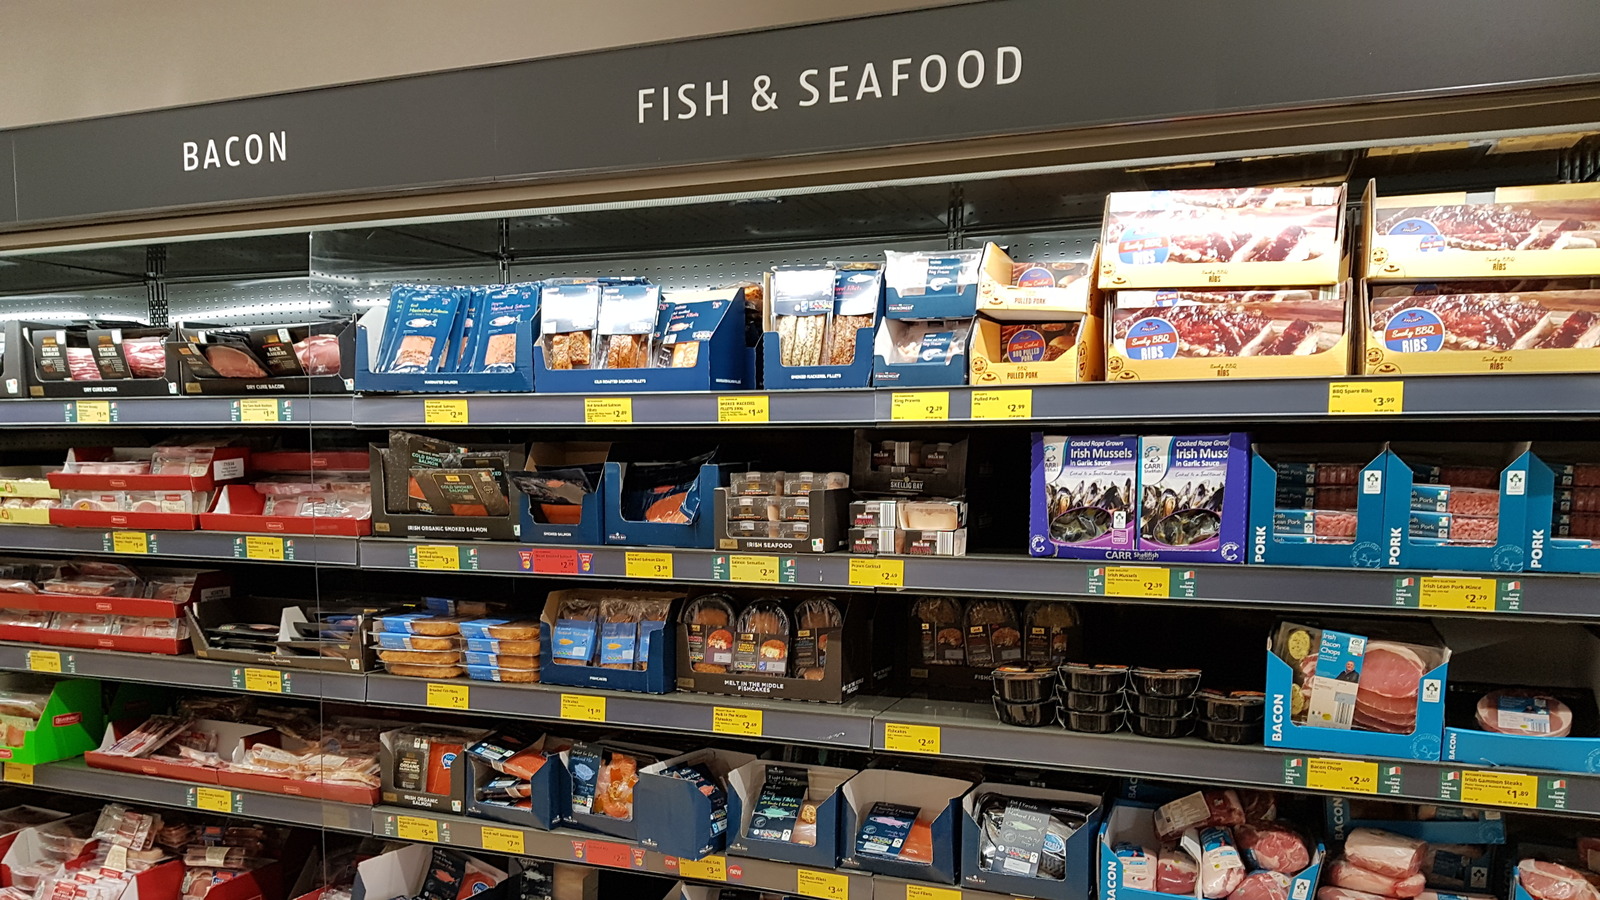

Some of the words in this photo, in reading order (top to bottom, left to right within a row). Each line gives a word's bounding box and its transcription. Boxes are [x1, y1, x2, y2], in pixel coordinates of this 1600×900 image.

[637, 79, 731, 125] FISH
[750, 74, 779, 112] &
[798, 45, 1024, 108] SEAFOOD
[183, 130, 288, 172] BACON
[1492, 262, 1506, 271] RIBS
[1208, 275, 1221, 283] RIBS
[1415, 325, 1436, 336] BBQ
[1152, 334, 1171, 343] BBQ
[1402, 337, 1428, 352] RIBS
[1141, 345, 1164, 360] RIBS
[1489, 362, 1504, 370] RIBS
[1024, 371, 1038, 379] PORK
[1216, 369, 1230, 377] RIBS
[1373, 397, 1395, 407] €3.99
[925, 405, 943, 414] €2.29
[1007, 404, 1025, 412] €2.99
[1091, 440, 1105, 448] Rope
[1196, 440, 1210, 448] Rope
[1070, 448, 1091, 459] Irish
[1092, 448, 1133, 459] Mussels
[1176, 448, 1197, 459] Irish
[1199, 448, 1228, 459] Muss
[890, 481, 912, 489] SKELLIG
[912, 482, 923, 490] BAY
[1418, 496, 1434, 504] Pork
[1254, 525, 1267, 563] PORK
[1388, 527, 1402, 566] PORK
[1530, 529, 1545, 569] PORK
[1105, 551, 1132, 560] CARR
[1133, 551, 1159, 559] Shellfish
[1143, 582, 1163, 591] €2.39
[1465, 594, 1488, 603] €2.79
[1322, 632, 1337, 641] Irish
[1321, 640, 1341, 649] Bacon
[1320, 646, 1341, 657] Chops
[737, 685, 771, 693] FISHCAKES
[761, 682, 784, 690] MIDDLE
[1271, 693, 1284, 742] BACON
[1448, 732, 1457, 760] BACON
[1507, 790, 1529, 799] €1.89
[412, 800, 432, 808] SALMON
[417, 796, 439, 804] ORGANIC
[1335, 798, 1343, 841] BACON
[1107, 861, 1117, 900] BACON
